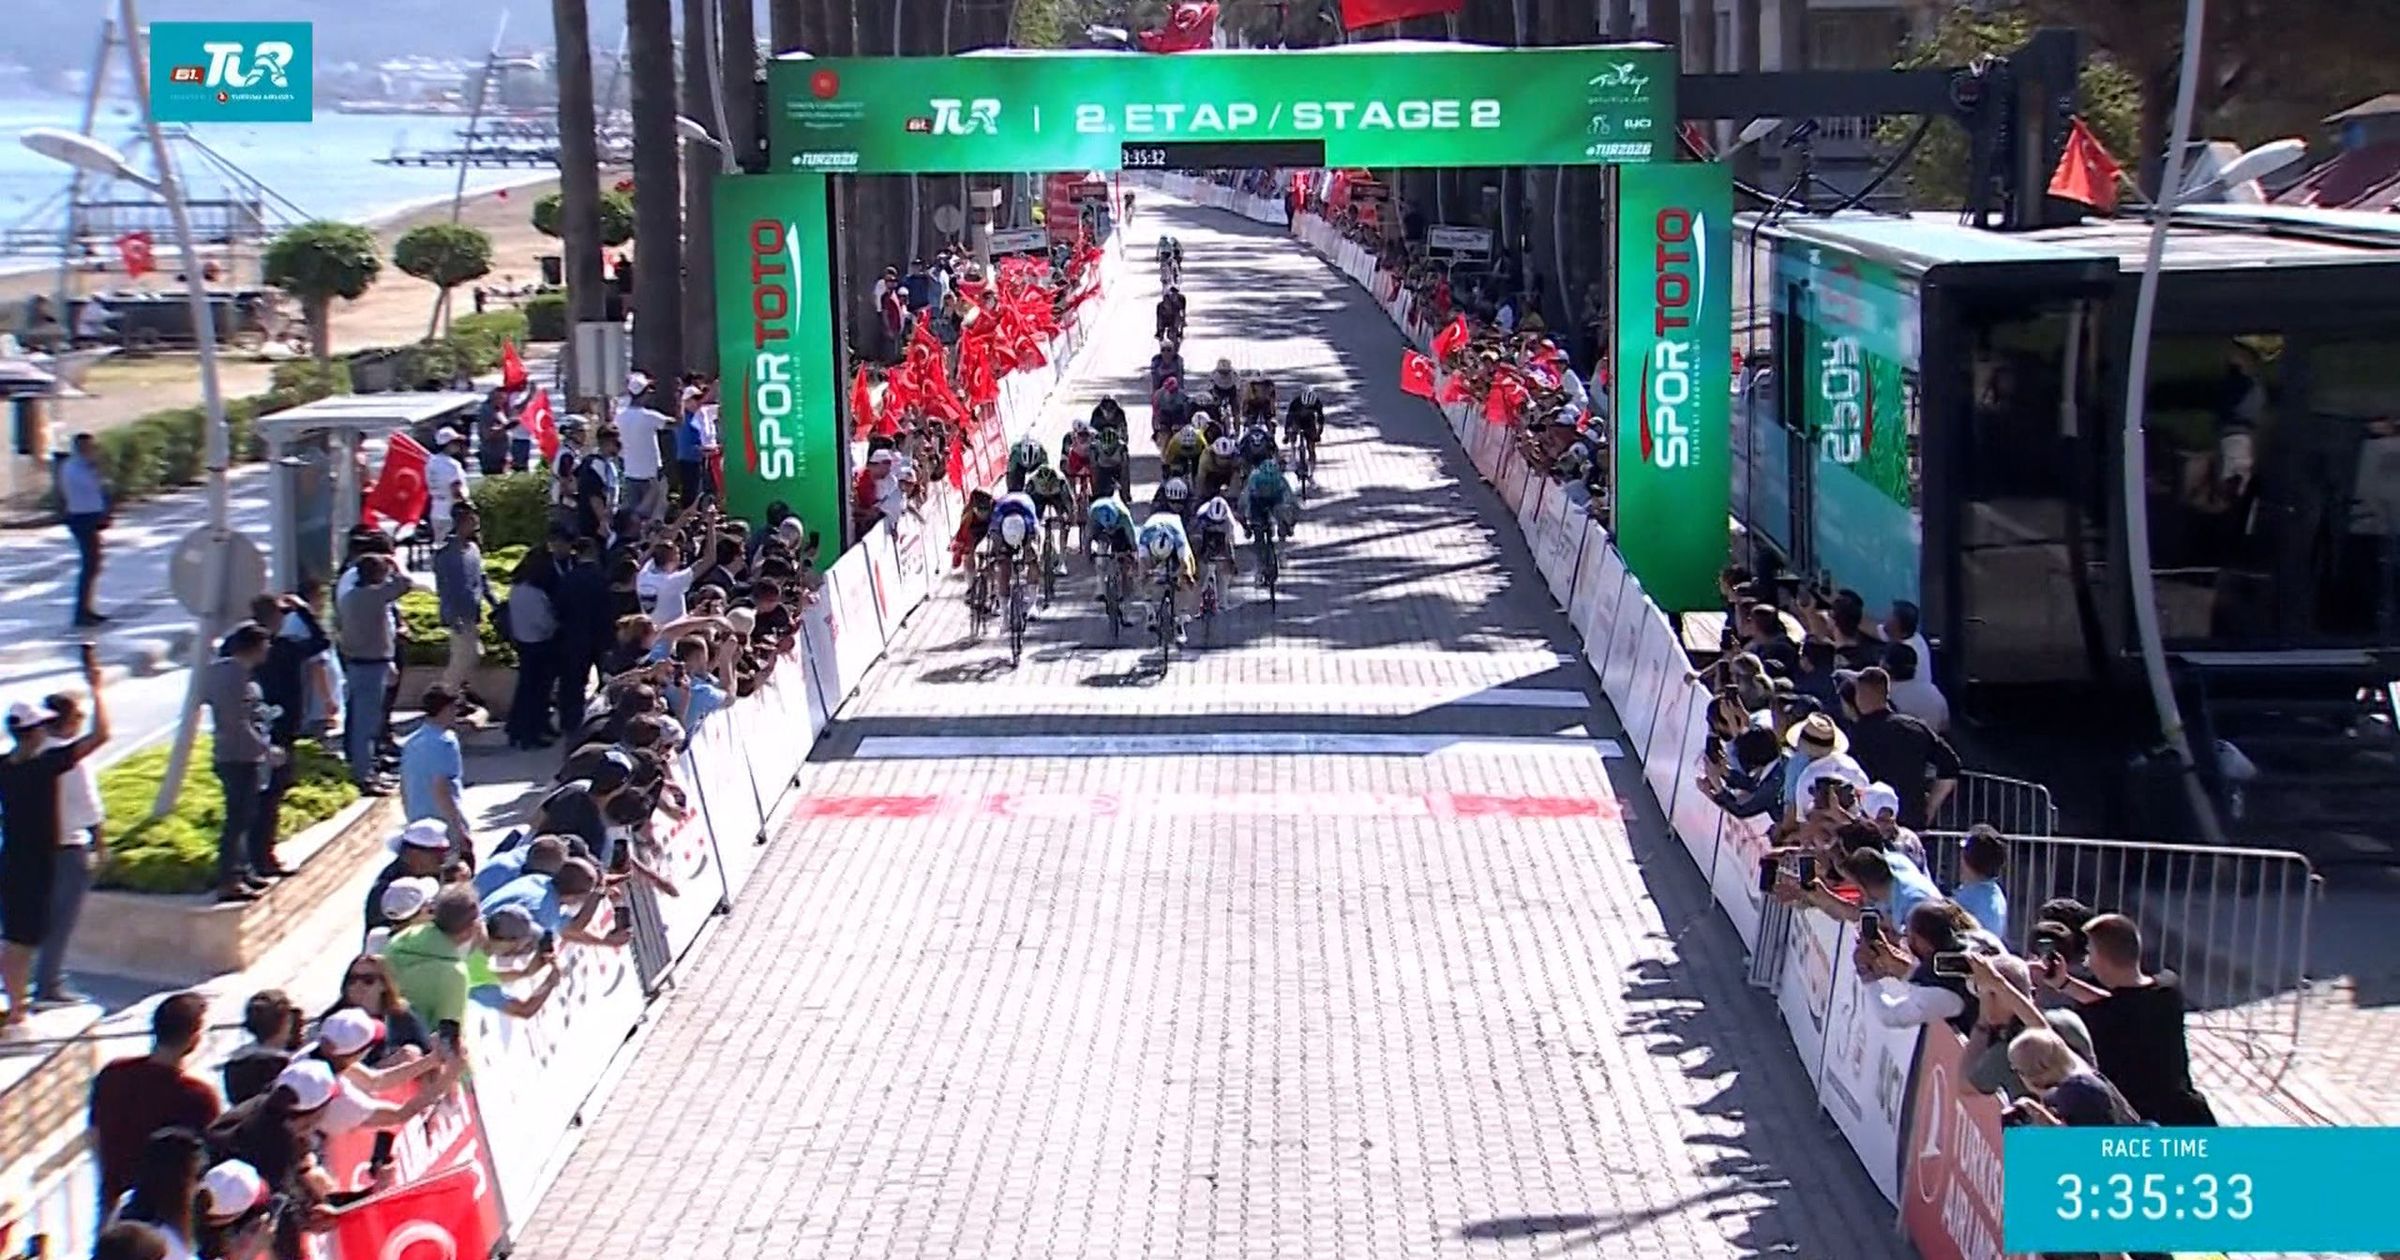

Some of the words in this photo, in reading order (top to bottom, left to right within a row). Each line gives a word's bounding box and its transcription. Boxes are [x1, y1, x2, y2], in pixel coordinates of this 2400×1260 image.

[1125, 103, 1258, 132] ETAP
[1293, 101, 1461, 130] STAGE
[1470, 100, 1501, 128] 2
